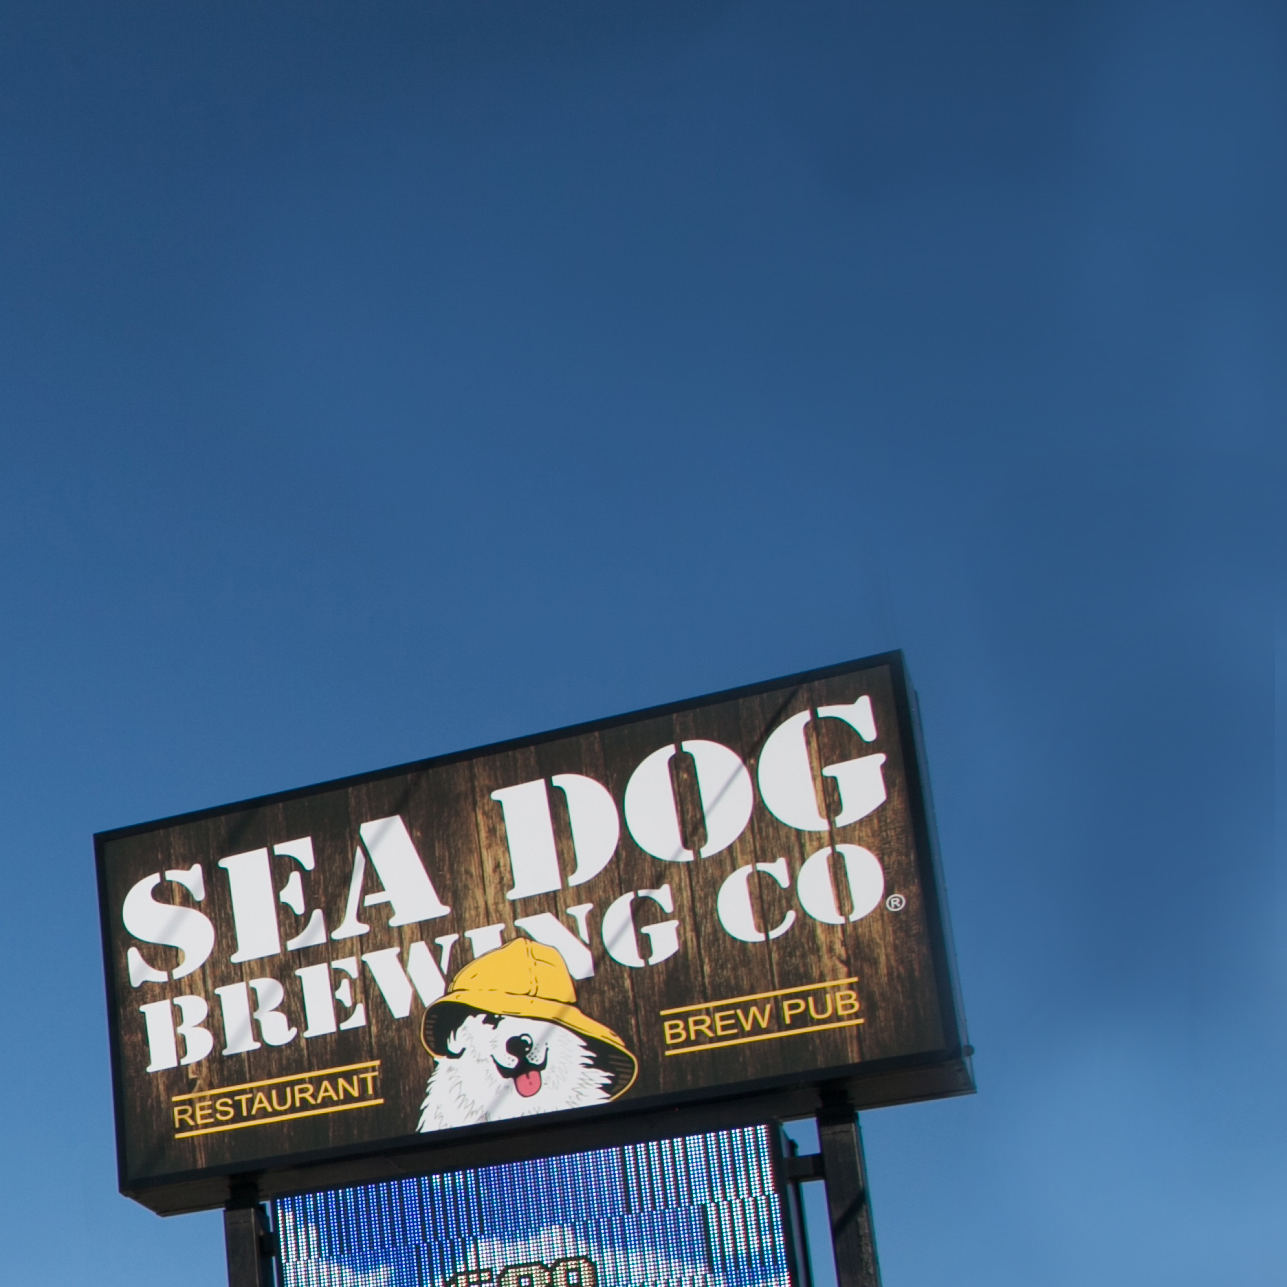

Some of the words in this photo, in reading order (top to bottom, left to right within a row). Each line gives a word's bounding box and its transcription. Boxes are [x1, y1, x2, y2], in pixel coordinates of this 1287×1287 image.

[122, 814, 451, 988] SEA
[490, 695, 888, 901] DOG
[663, 1003, 772, 1045] BREW
[783, 990, 860, 1025] PUB
[173, 1071, 379, 1129] RESTAURANT
